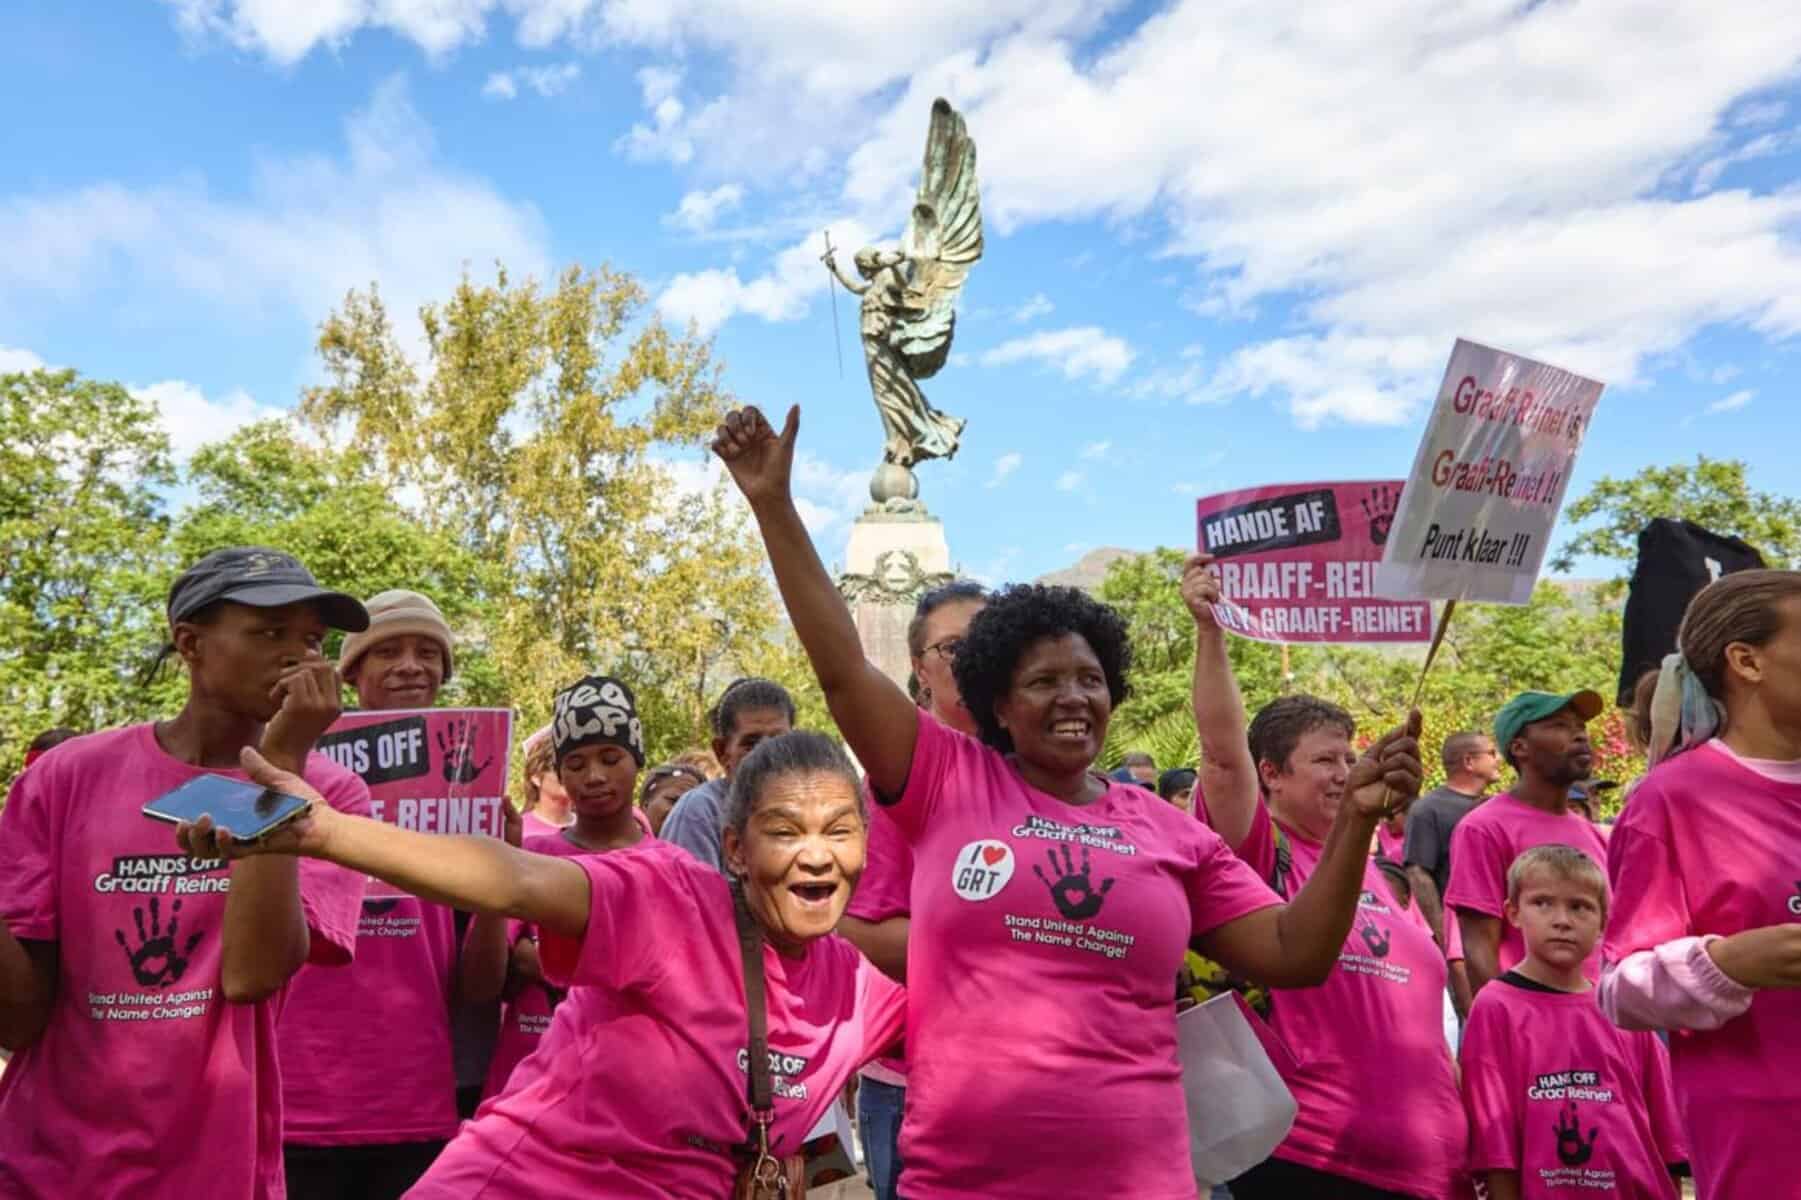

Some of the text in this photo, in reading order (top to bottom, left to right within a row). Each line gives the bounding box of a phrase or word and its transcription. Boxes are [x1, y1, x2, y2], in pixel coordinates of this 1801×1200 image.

[1206, 501, 1325, 549] HANDE AF
[1420, 523, 1464, 560] Punt
[1462, 528, 1508, 565] klaar
[1205, 562, 1379, 599] RAAFF-REI
[1261, 605, 1425, 633] GRAAFF-REINET
[377, 728, 423, 769] OFF
[118, 857, 187, 876] HANDS
[971, 844, 983, 865] I
[95, 873, 231, 894] Graaff Reine
[957, 867, 1001, 894] GRT
[1005, 914, 1135, 945] Stand United Against
[1011, 928, 1127, 958] The Name Change!
[119, 992, 163, 1005] United
[166, 989, 213, 1006] Against
[107, 1008, 149, 1020] Name
[152, 1004, 206, 1020] Change!
[1572, 1072, 1597, 1084] OFF
